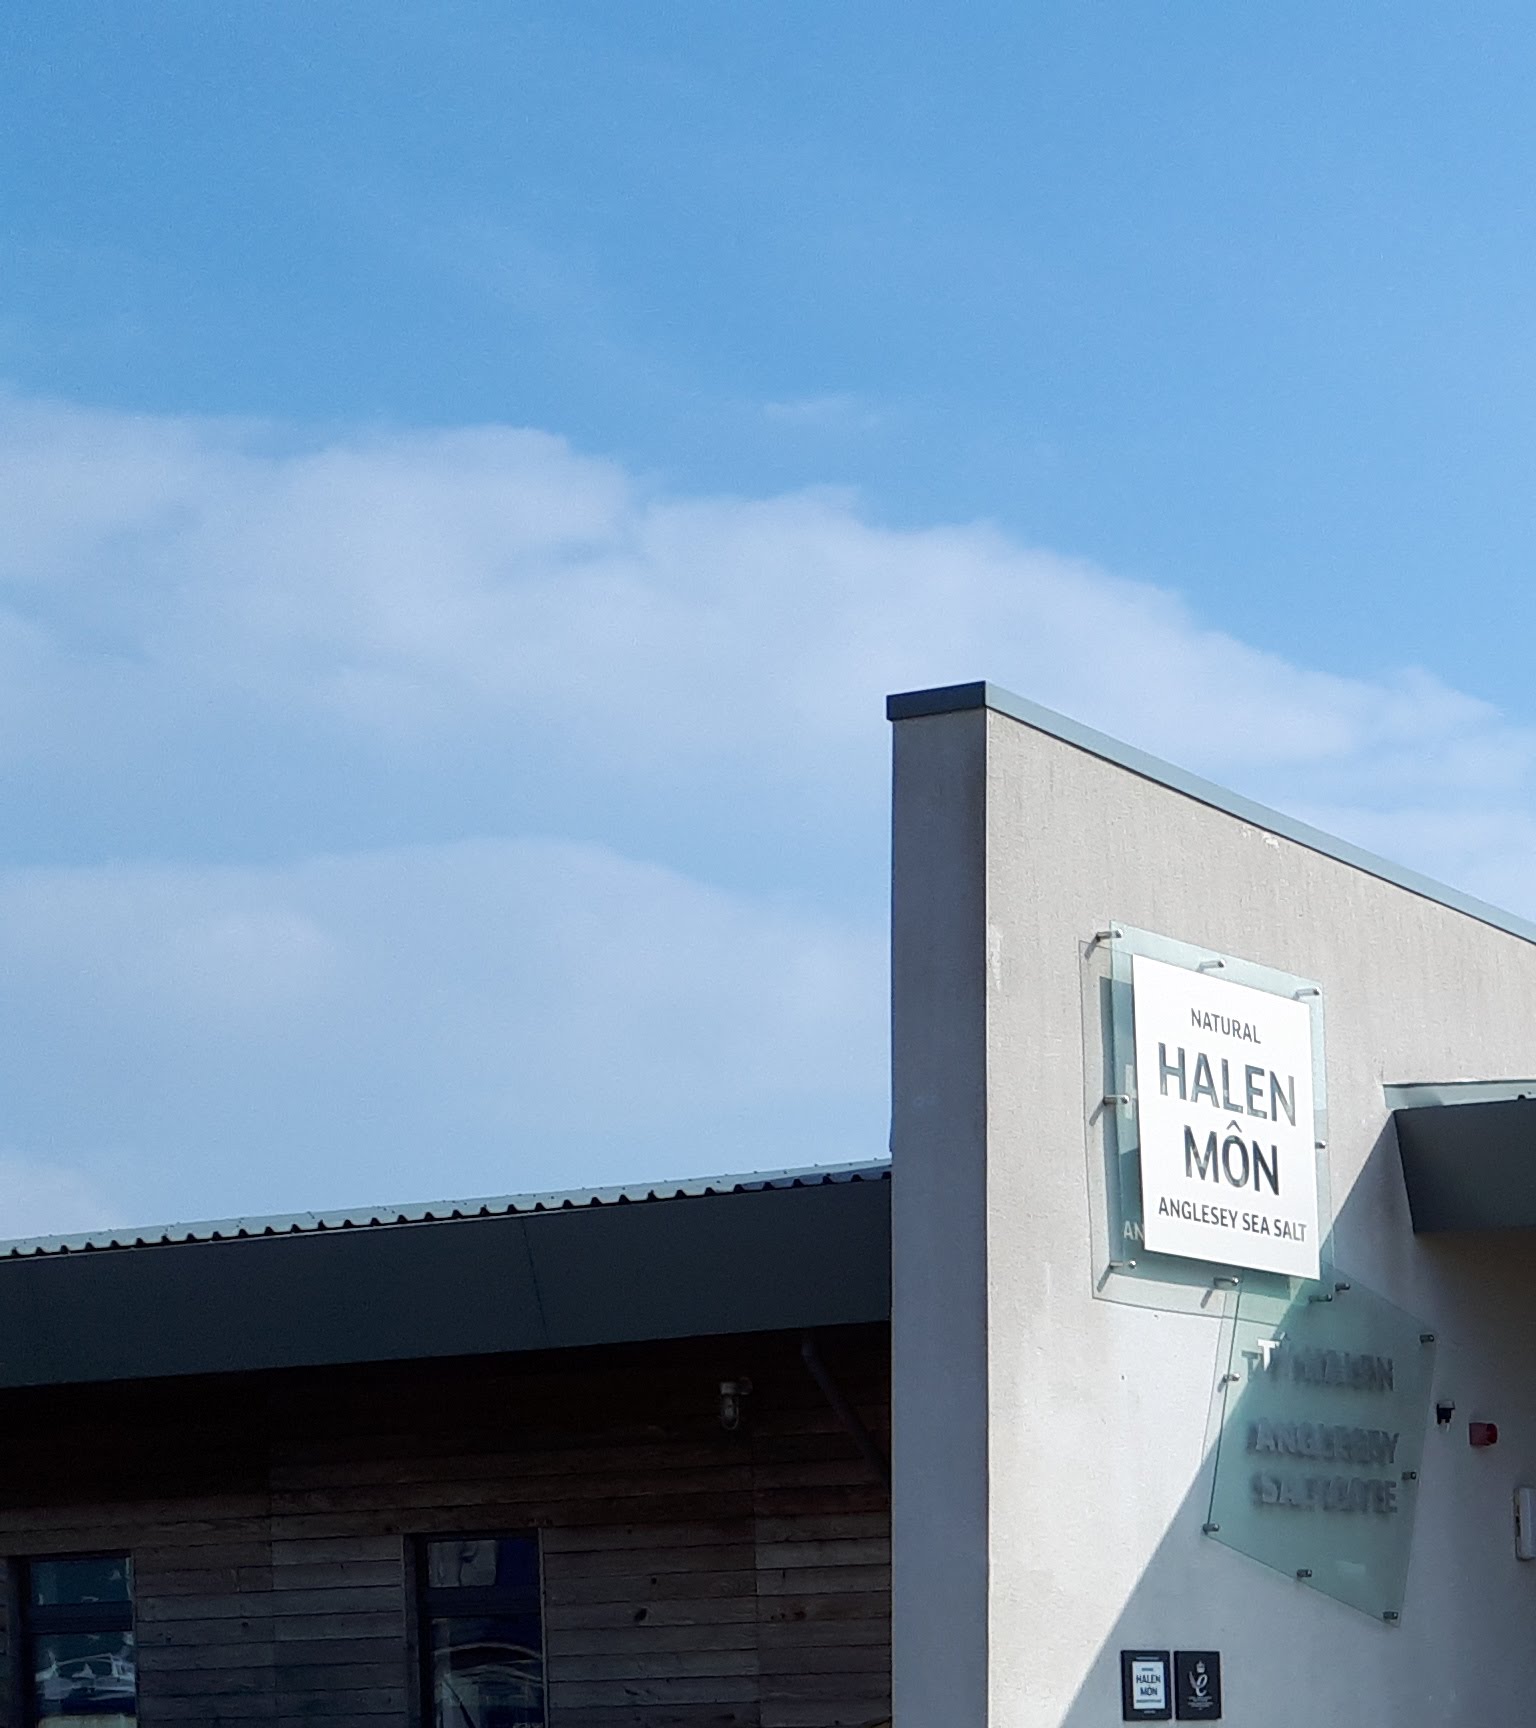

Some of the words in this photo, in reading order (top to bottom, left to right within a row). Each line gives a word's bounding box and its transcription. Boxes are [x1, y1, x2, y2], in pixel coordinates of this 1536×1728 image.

[1190, 1007, 1261, 1044] NATURAL
[1157, 1042, 1296, 1127] HALEN
[1183, 1120, 1280, 1196] MÔN
[1158, 1197, 1239, 1229] ANGLESEY
[1242, 1212, 1270, 1236] SEA
[1274, 1218, 1307, 1242] SALT
